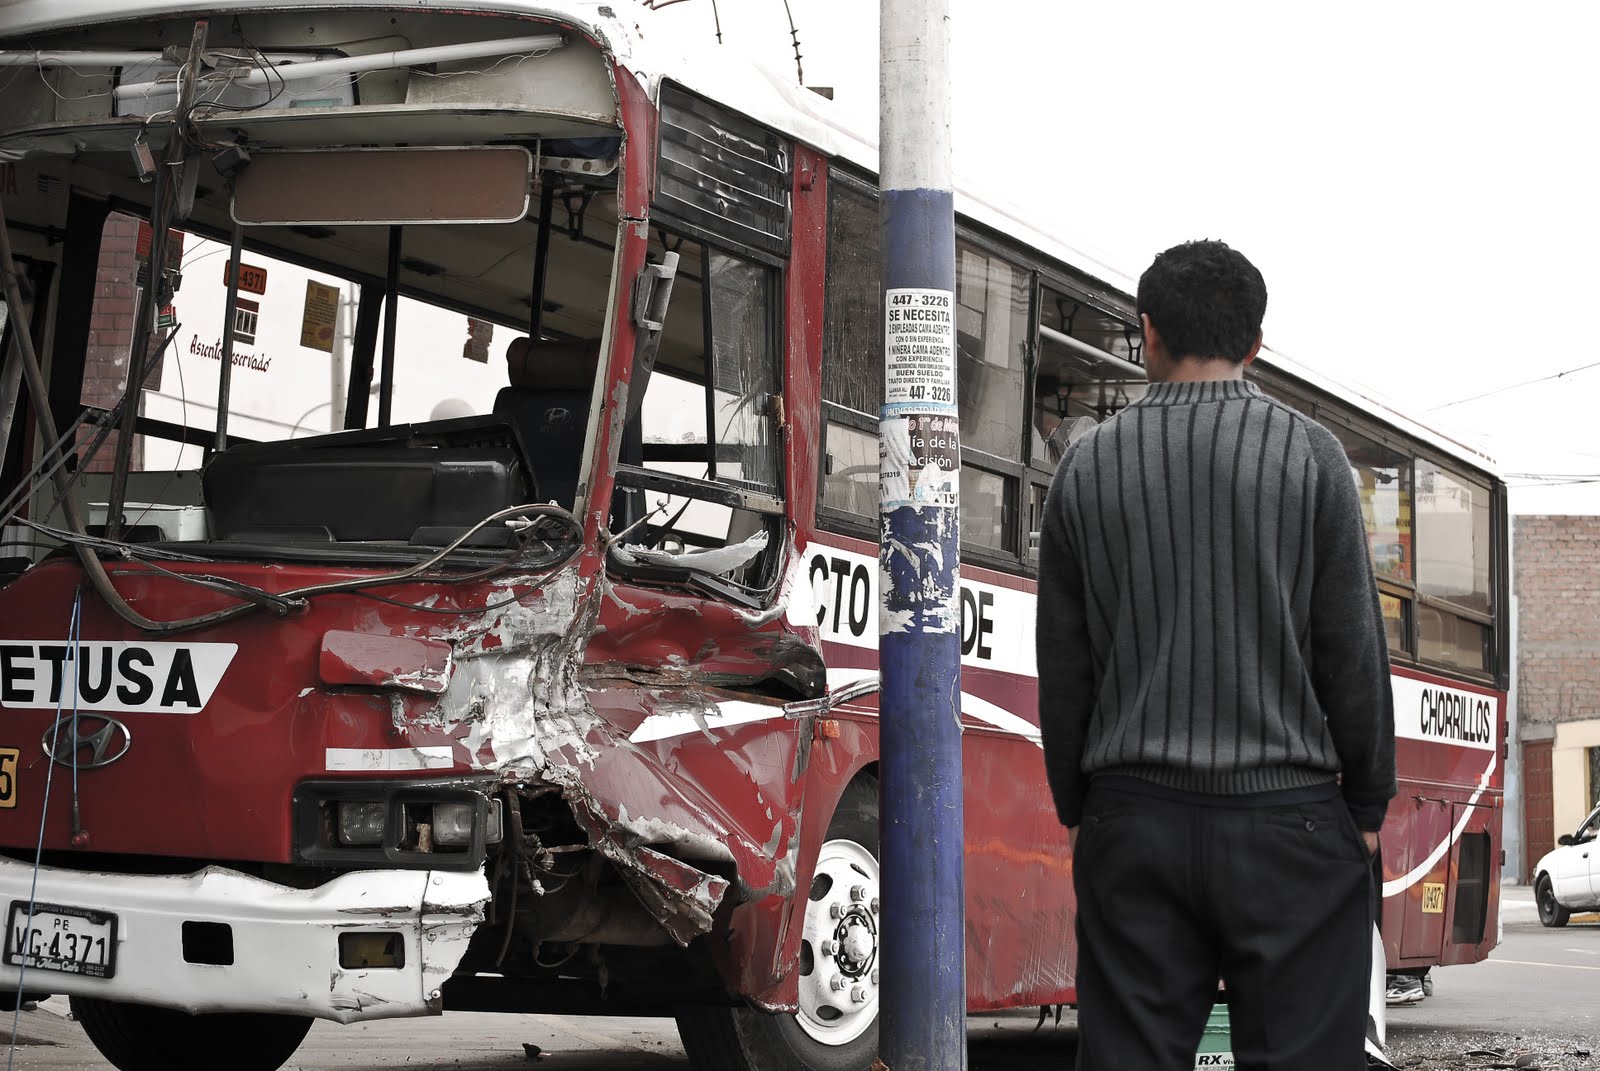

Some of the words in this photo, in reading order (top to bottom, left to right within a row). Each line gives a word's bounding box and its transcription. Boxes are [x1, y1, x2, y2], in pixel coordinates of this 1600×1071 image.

[889, 309, 900, 321] SE
[903, 309, 950, 323] NECESITA
[892, 323, 918, 334] EMPLEADAS
[918, 323, 931, 333] CAMA
[932, 324, 950, 336] ADENTRO
[190, 334, 223, 361] Asiento
[912, 345, 928, 355] CAMA
[929, 345, 951, 356] ADENTRO
[930, 416, 943, 431] de
[929, 435, 946, 448] de
[949, 437, 957, 450] la
[0, 645, 202, 708] ETUSA
[1420, 688, 1491, 744] CHORRILLOS
[0, 754, 16, 801] 5
[53, 918, 71, 931] PE
[1198, 1054, 1223, 1066] RX
